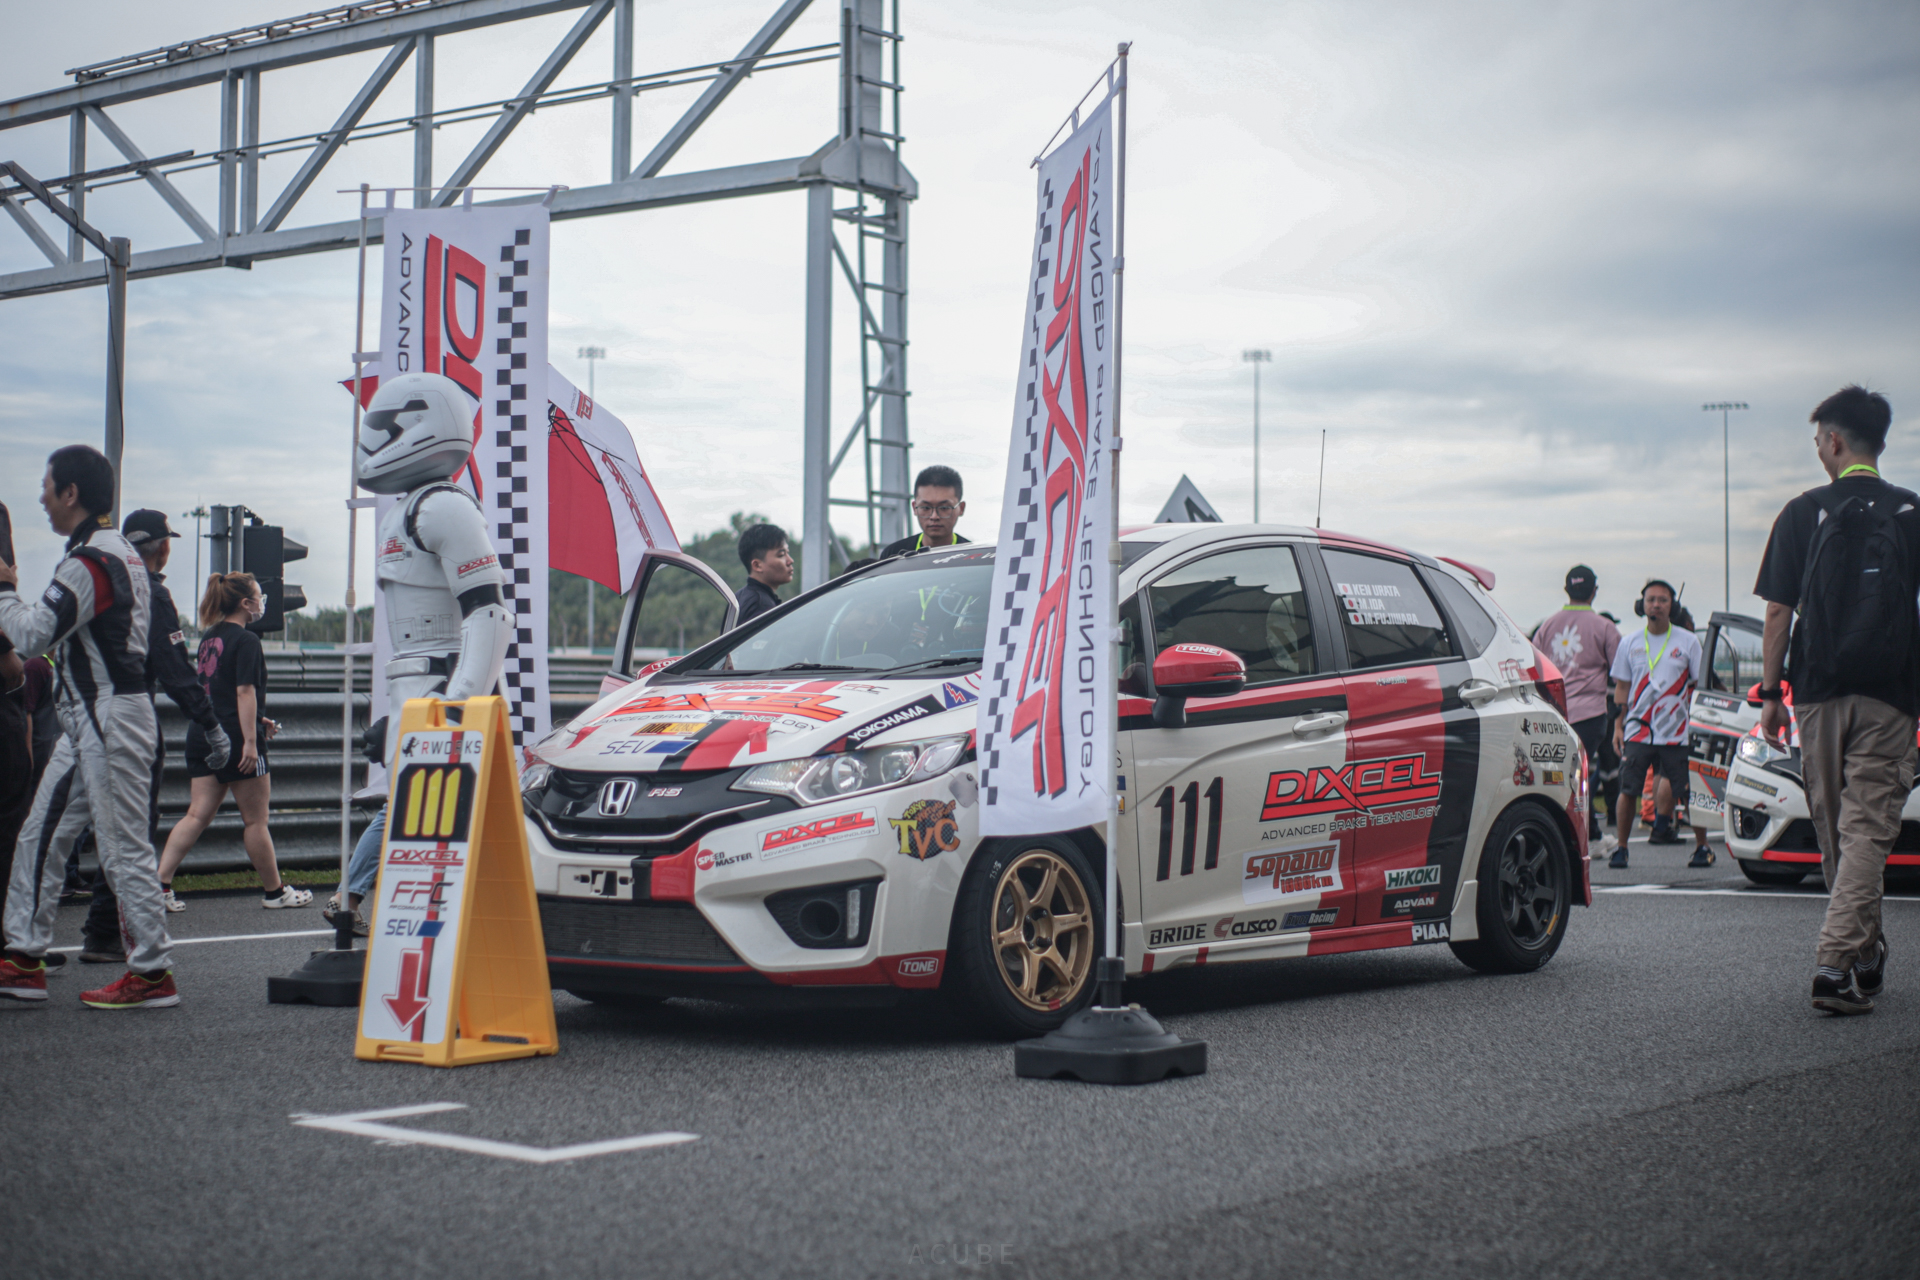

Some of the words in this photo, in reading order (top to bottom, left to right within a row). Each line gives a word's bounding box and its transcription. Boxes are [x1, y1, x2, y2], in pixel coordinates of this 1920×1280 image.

[397, 232, 413, 373] ADVANC
[1351, 584, 1373, 596] KEN
[1372, 584, 1401, 597] URATA
[1358, 598, 1386, 611] M.IDA
[1181, 644, 1219, 654] TONE
[651, 712, 706, 721] BRAKE
[707, 712, 822, 732] TECHNOLOGY
[847, 704, 929, 742] YOKOHAMA
[421, 739, 482, 755] RWORKS
[600, 738, 653, 756] SEV
[1530, 742, 1567, 758] RAYS
[647, 786, 684, 799] RS
[1259, 752, 1443, 823] DIXCEL
[403, 767, 462, 838] 111
[903, 799, 926, 819] TOKYO
[762, 810, 876, 851] DIXCEL
[1153, 776, 1224, 882] 111
[1261, 823, 1327, 841] ADVANCED
[1328, 815, 1367, 832] BRAKE
[1368, 804, 1442, 827] TECHNOLOGY
[763, 839, 802, 853] ADVANCED
[802, 833, 827, 843] BRAKE
[828, 823, 877, 837] TECHNOLOGY
[888, 817, 961, 862] TVC
[387, 848, 464, 867] DIXCEL
[697, 851, 725, 866] SPEED
[715, 852, 753, 868] MASTER
[1387, 867, 1440, 888] HiKOKI
[391, 880, 455, 905] FPC
[1394, 896, 1435, 909] ADVAN
[385, 918, 420, 936] SEV
[1308, 911, 1337, 924] Racing
[1149, 923, 1208, 946] BRIDE
[1230, 918, 1278, 937] CUSCO
[1411, 922, 1450, 942] PIAA
[901, 958, 938, 975] TONE
